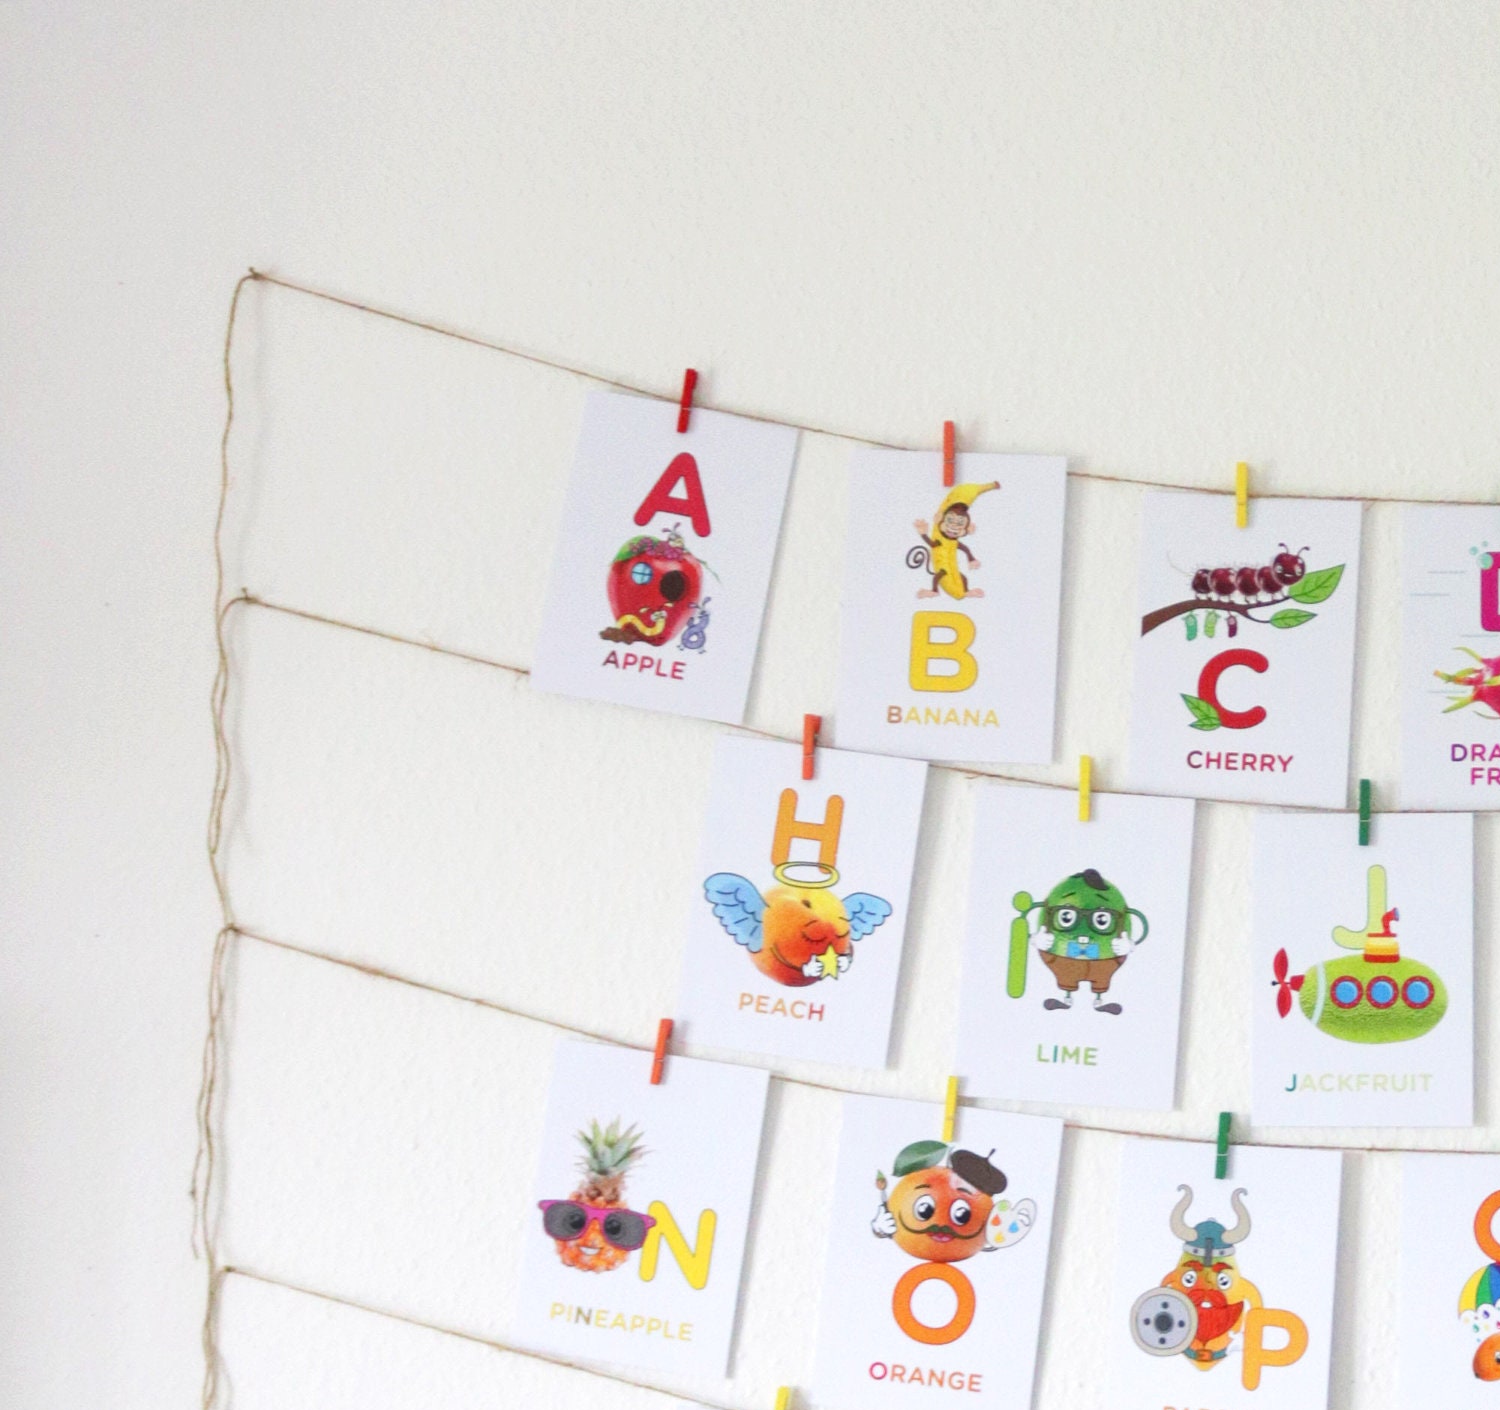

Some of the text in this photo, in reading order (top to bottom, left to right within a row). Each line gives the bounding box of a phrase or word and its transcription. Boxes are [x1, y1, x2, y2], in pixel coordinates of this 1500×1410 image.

[634, 452, 711, 538] A
[602, 650, 687, 681] APPLE
[908, 610, 978, 693] B
[886, 706, 1000, 729] BANANA
[1197, 648, 1269, 730] C
[1186, 750, 1294, 774] CHERRY
[771, 788, 845, 874] H
[1332, 864, 1388, 950] J
[738, 992, 826, 1022] PEACH
[1036, 1043, 1099, 1067] LIME
[1285, 1073, 1433, 1093] JACKFRUIT
[639, 1200, 717, 1290] N
[549, 1301, 694, 1343] PINEAPPLE
[892, 1261, 976, 1346] O
[868, 1361, 983, 1393] ORANGE
[1241, 1307, 1309, 1392] P
